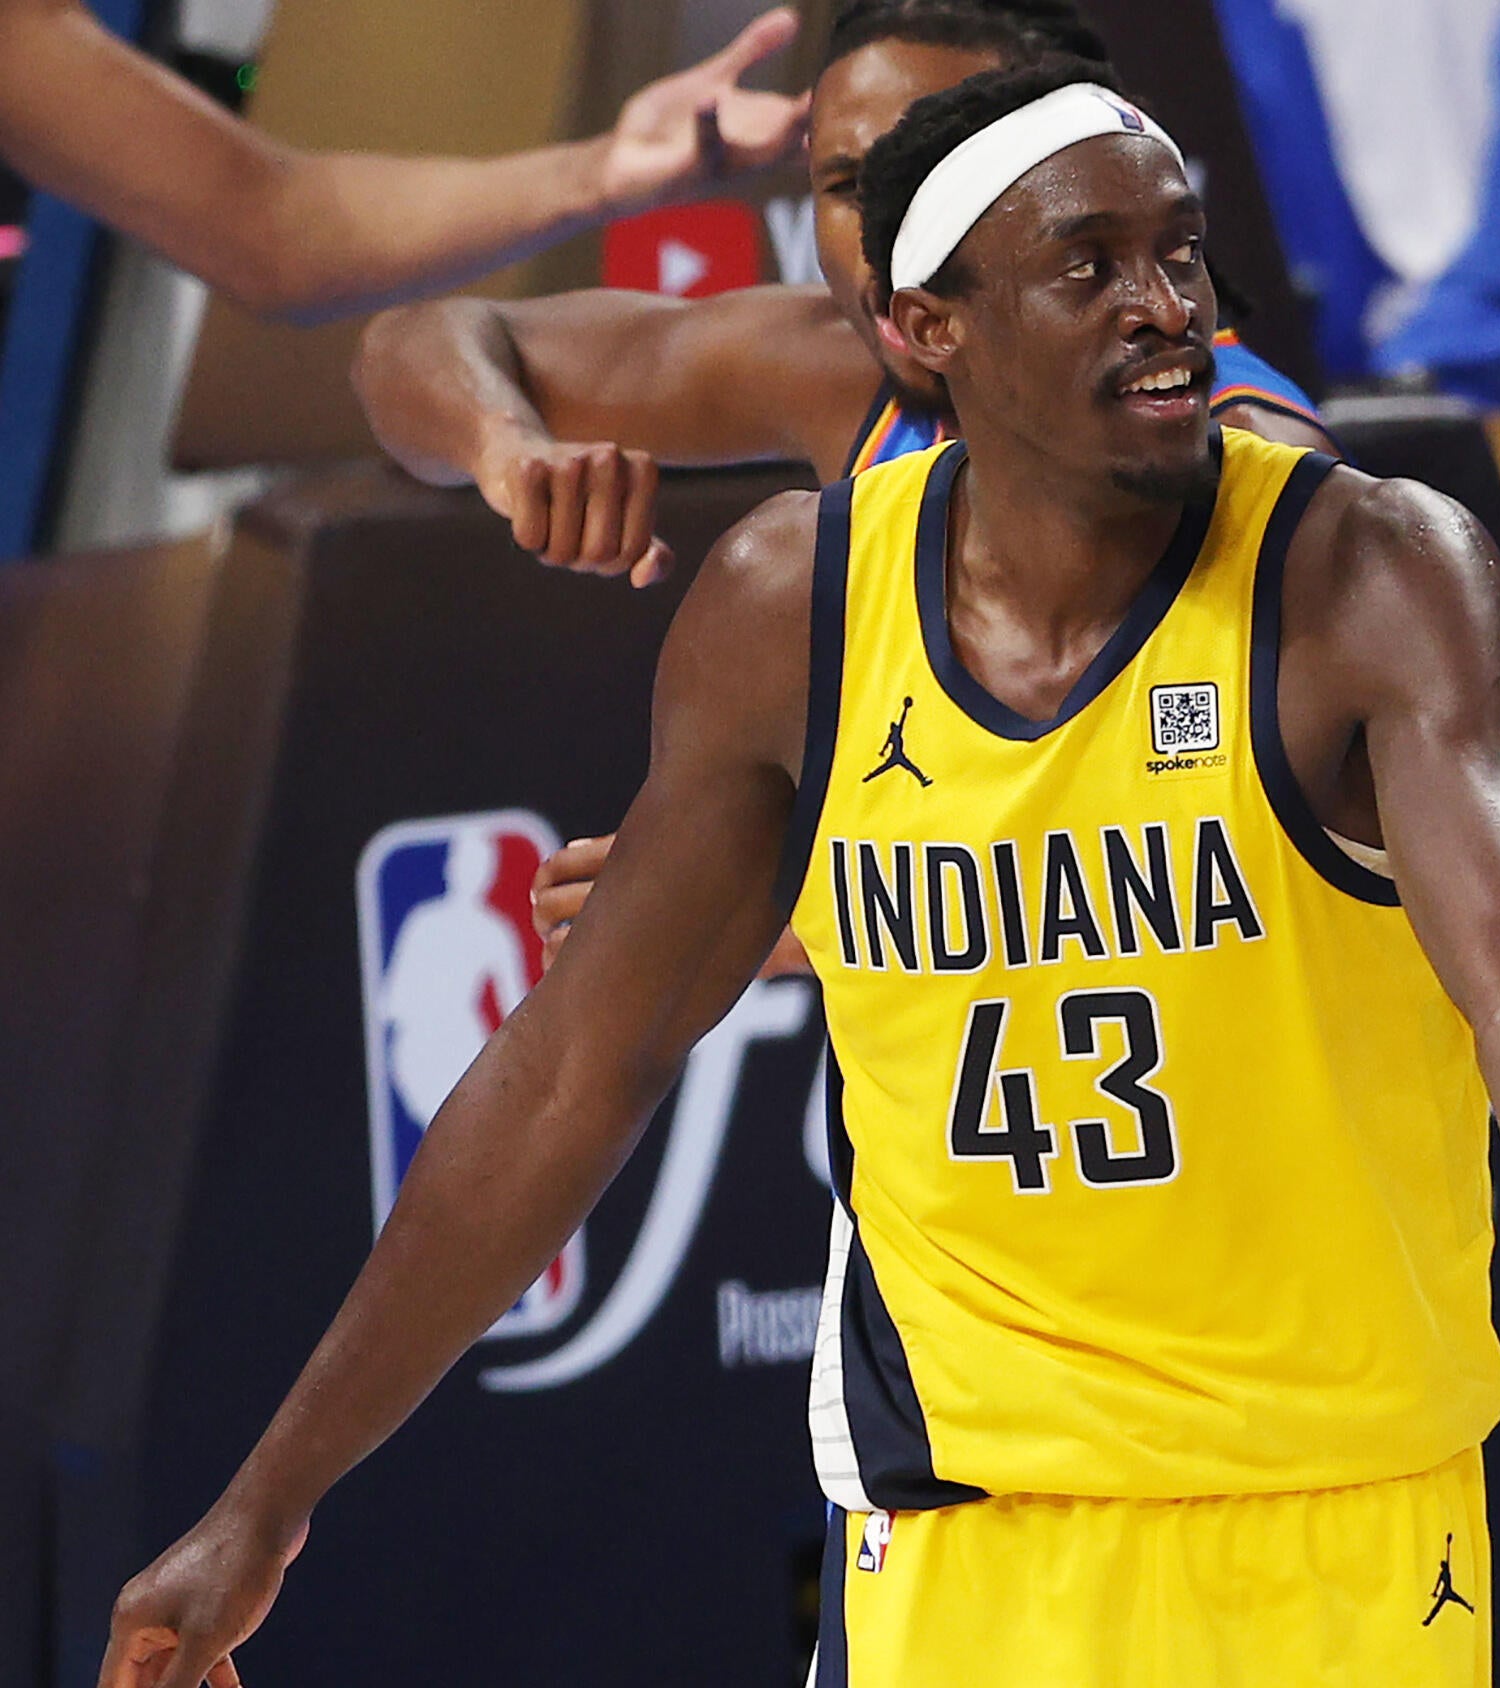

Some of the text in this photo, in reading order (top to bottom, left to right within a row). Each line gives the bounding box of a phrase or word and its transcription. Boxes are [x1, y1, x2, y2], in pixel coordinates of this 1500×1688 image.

[1146, 754, 1228, 775] spokenote
[829, 816, 1266, 974] INDIANA
[945, 985, 1182, 1195] 43
